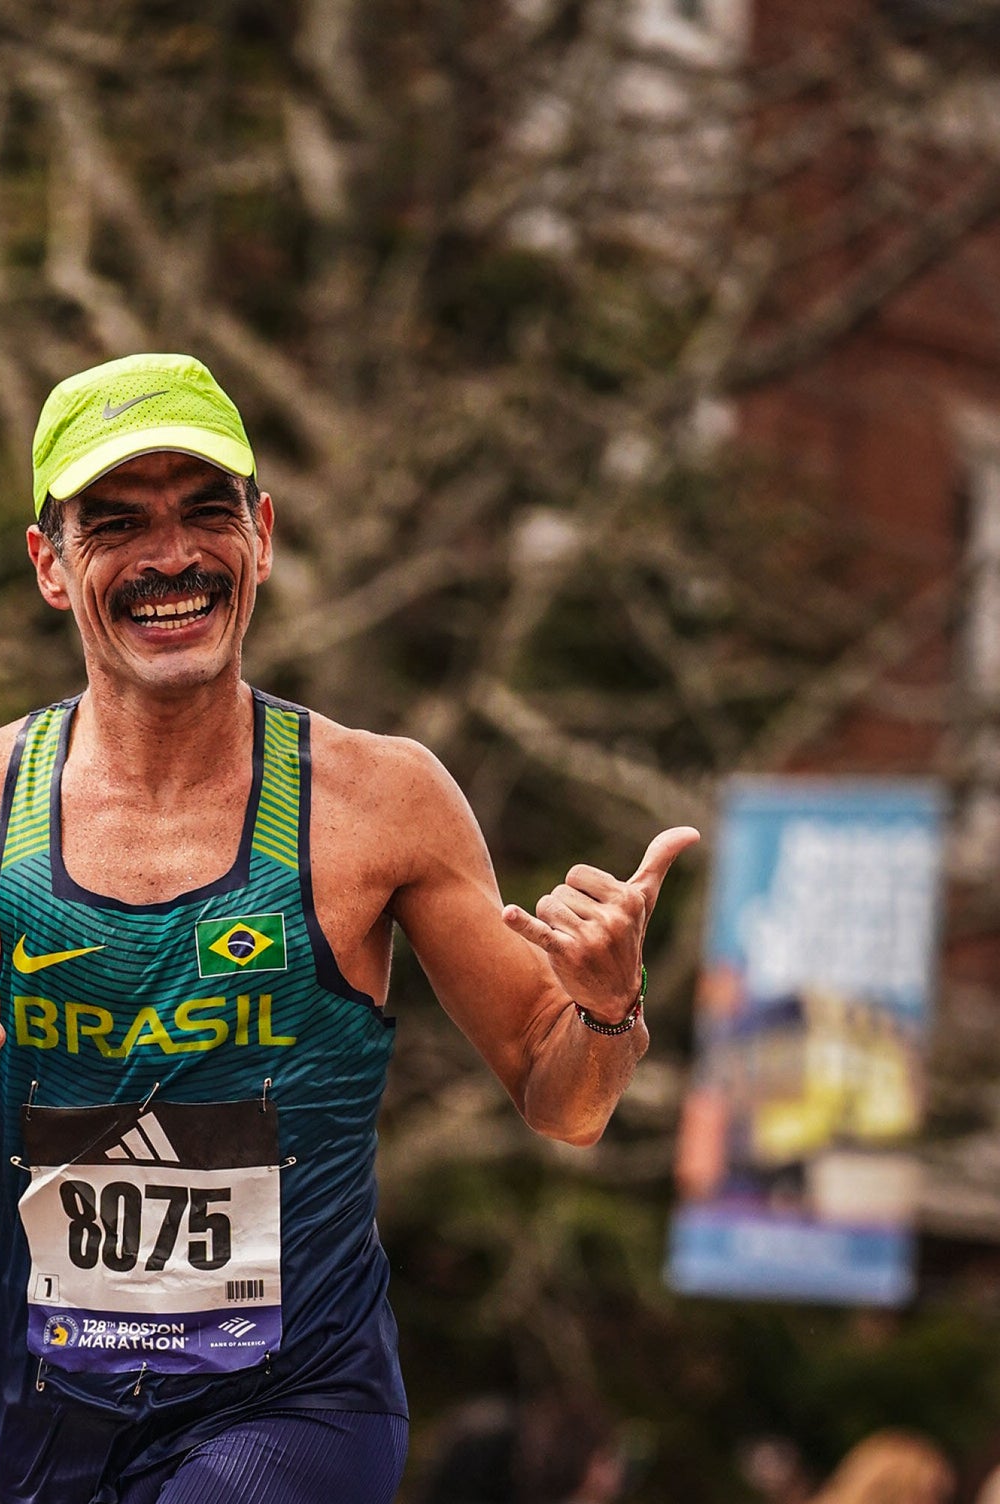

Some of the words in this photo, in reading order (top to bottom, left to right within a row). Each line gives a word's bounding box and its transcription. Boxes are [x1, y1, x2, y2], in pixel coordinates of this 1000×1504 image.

[13, 994, 297, 1058] BRASIL
[59, 1180, 232, 1273] 8075
[77, 1334, 185, 1350] MARATHON
[116, 1321, 185, 1335] BOSTON
